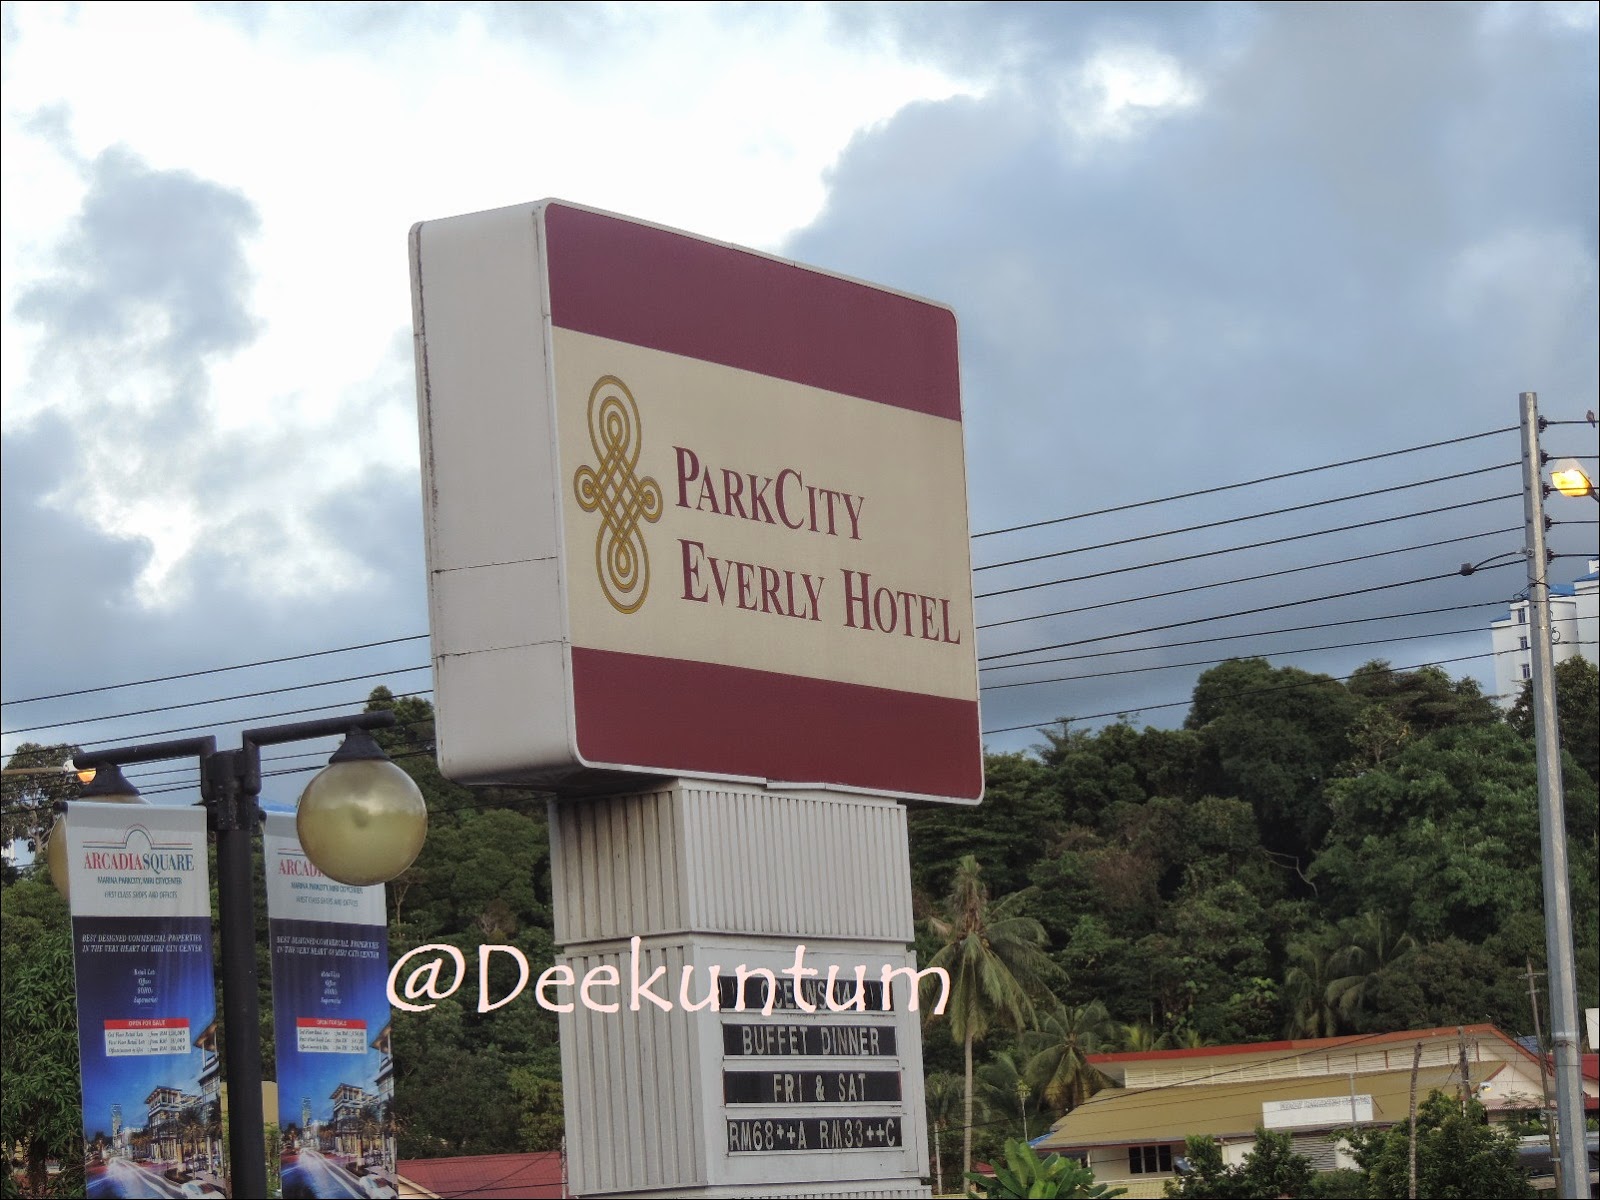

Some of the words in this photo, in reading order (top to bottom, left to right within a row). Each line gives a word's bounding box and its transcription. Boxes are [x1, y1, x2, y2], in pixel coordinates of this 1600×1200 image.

[82, 933, 97, 943] BEST
[98, 933, 127, 943] DESIGNED
[128, 933, 167, 943] COMMERCIAL
[167, 933, 202, 942] PROPERTIES
[82, 945, 89, 953] IN
[91, 944, 103, 953] THE
[104, 944, 119, 953] VERY
[120, 944, 140, 953] HEART
[141, 944, 149, 953] OF
[178, 944, 203, 953] CENTER
[742, 1026, 808, 1055] BUFFET
[820, 1027, 880, 1055] DINNER
[773, 1074, 803, 1102] FRI
[815, 1075, 825, 1101] &
[838, 1073, 866, 1101] SAT
[819, 1118, 896, 1148] RM33++C
